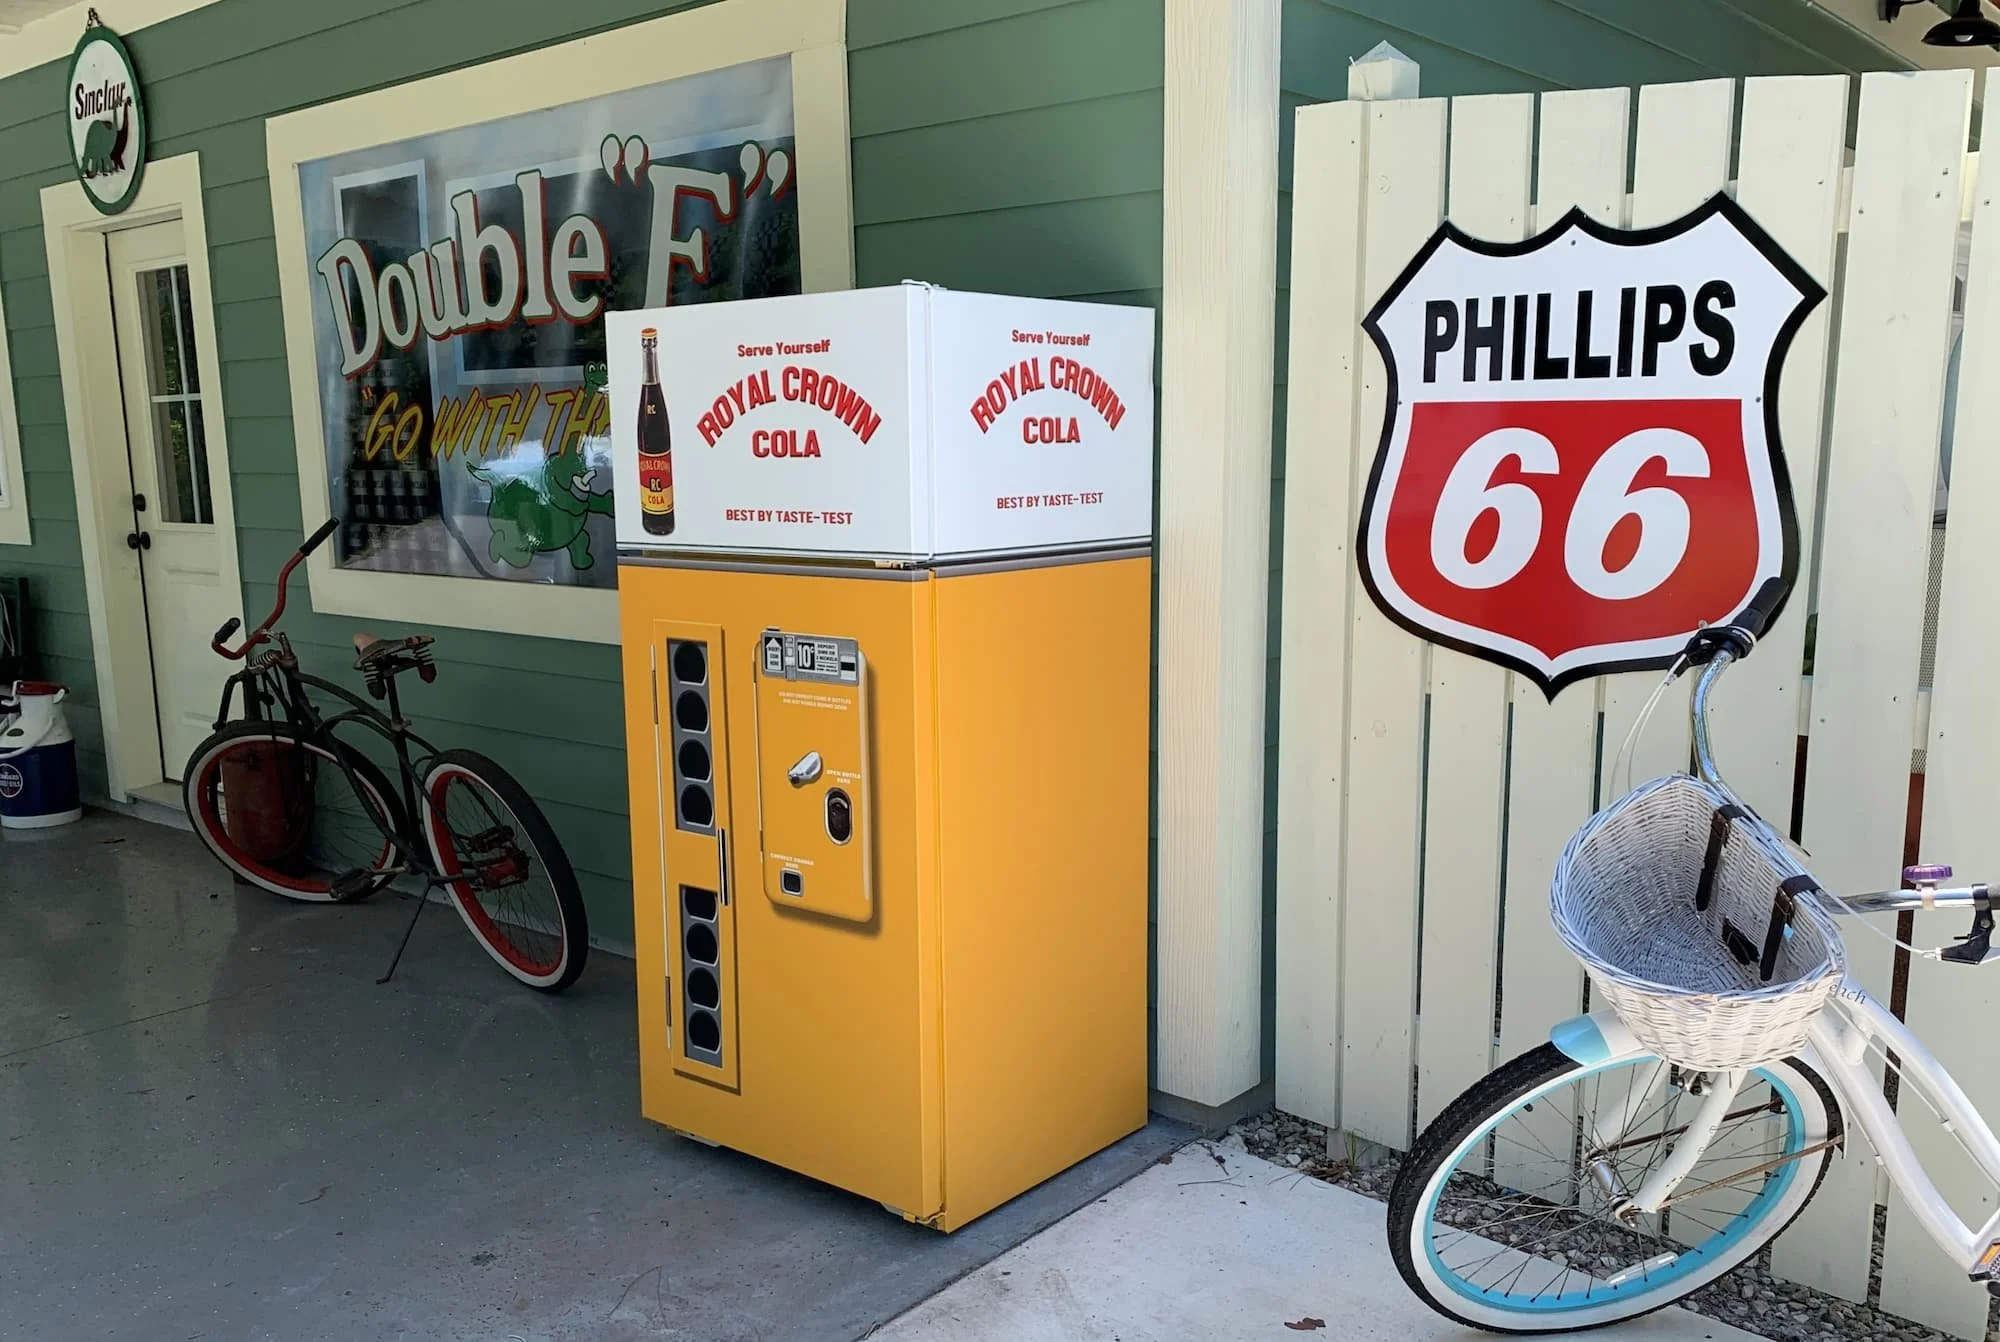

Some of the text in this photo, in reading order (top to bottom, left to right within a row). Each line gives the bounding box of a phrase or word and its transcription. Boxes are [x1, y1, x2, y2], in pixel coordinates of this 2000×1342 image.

[75, 80, 126, 119] Sinclair
[316, 169, 611, 379] Double
[1011, 329, 1091, 346] Serve Yourself
[1423, 280, 1736, 383] PHILLIPS
[737, 339, 831, 357] Serve Yourself
[696, 366, 882, 448] ROYAL CROWN
[970, 355, 1126, 434] ROYAL CROWN
[431, 383, 541, 460] WITH
[1023, 416, 1080, 444] COLA
[752, 429, 821, 458] COLA
[650, 478, 661, 492] RC
[648, 496, 665, 505] COLA
[997, 492, 1104, 509] BEST BY TASTE-TEST
[1430, 427, 1711, 600] 66
[726, 509, 853, 525] BEST BY TASTE-TEST
